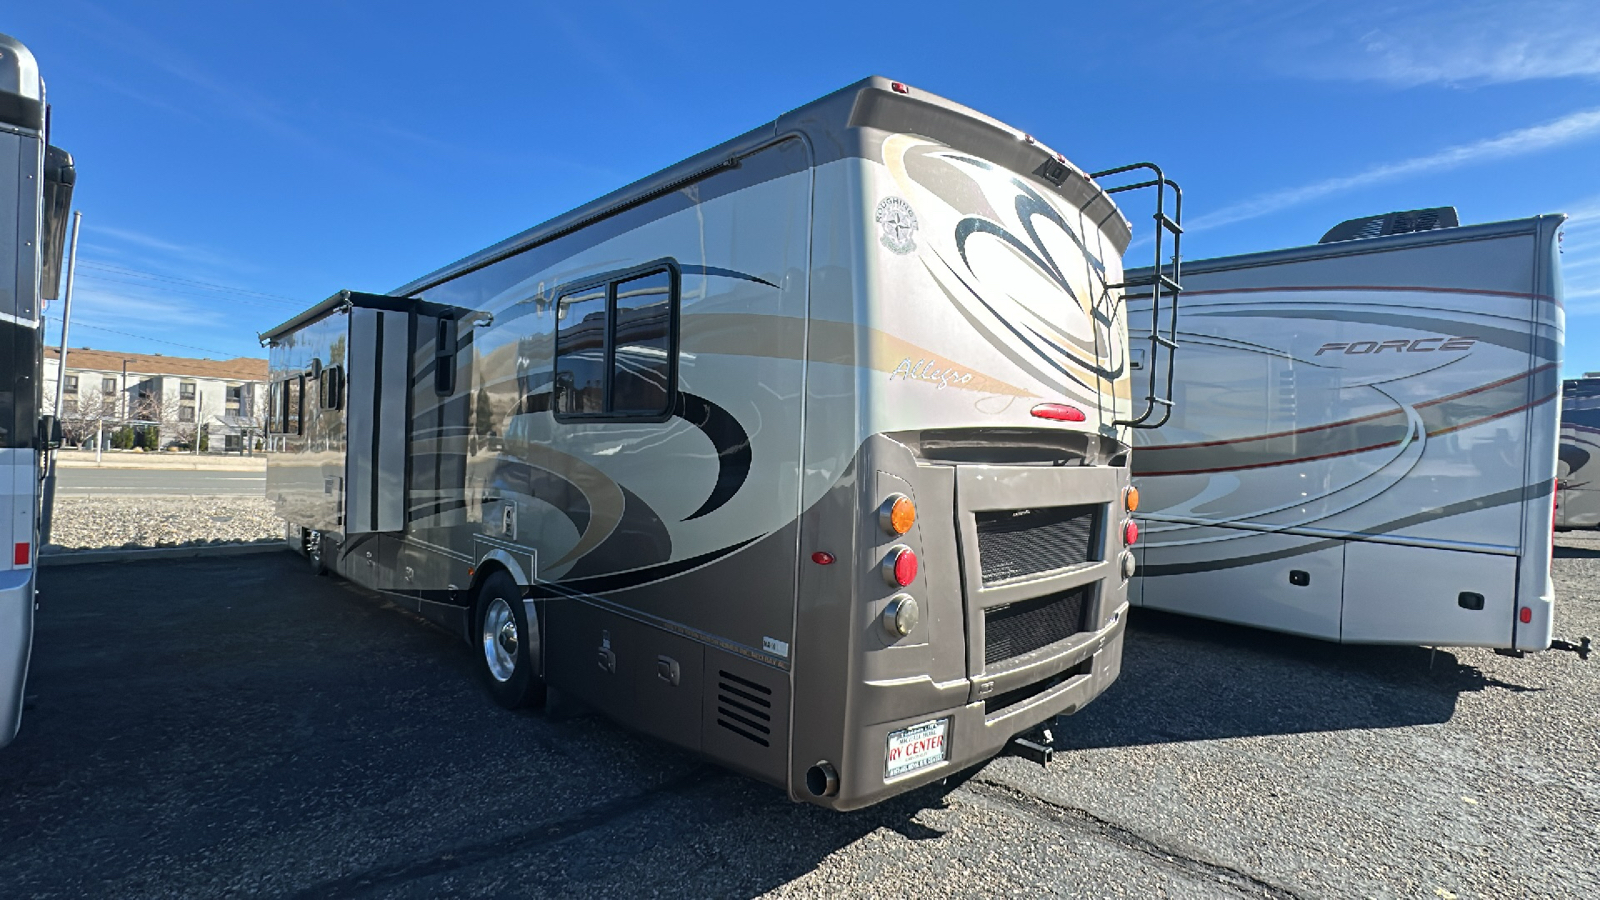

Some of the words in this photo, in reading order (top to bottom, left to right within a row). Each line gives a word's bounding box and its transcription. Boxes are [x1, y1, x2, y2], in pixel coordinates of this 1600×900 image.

[875, 197, 915, 223] ROUGHING
[1314, 336, 1480, 356] FORCE
[889, 357, 972, 390] Allegro
[889, 746, 904, 761] RV
[905, 735, 944, 756] CENTER
